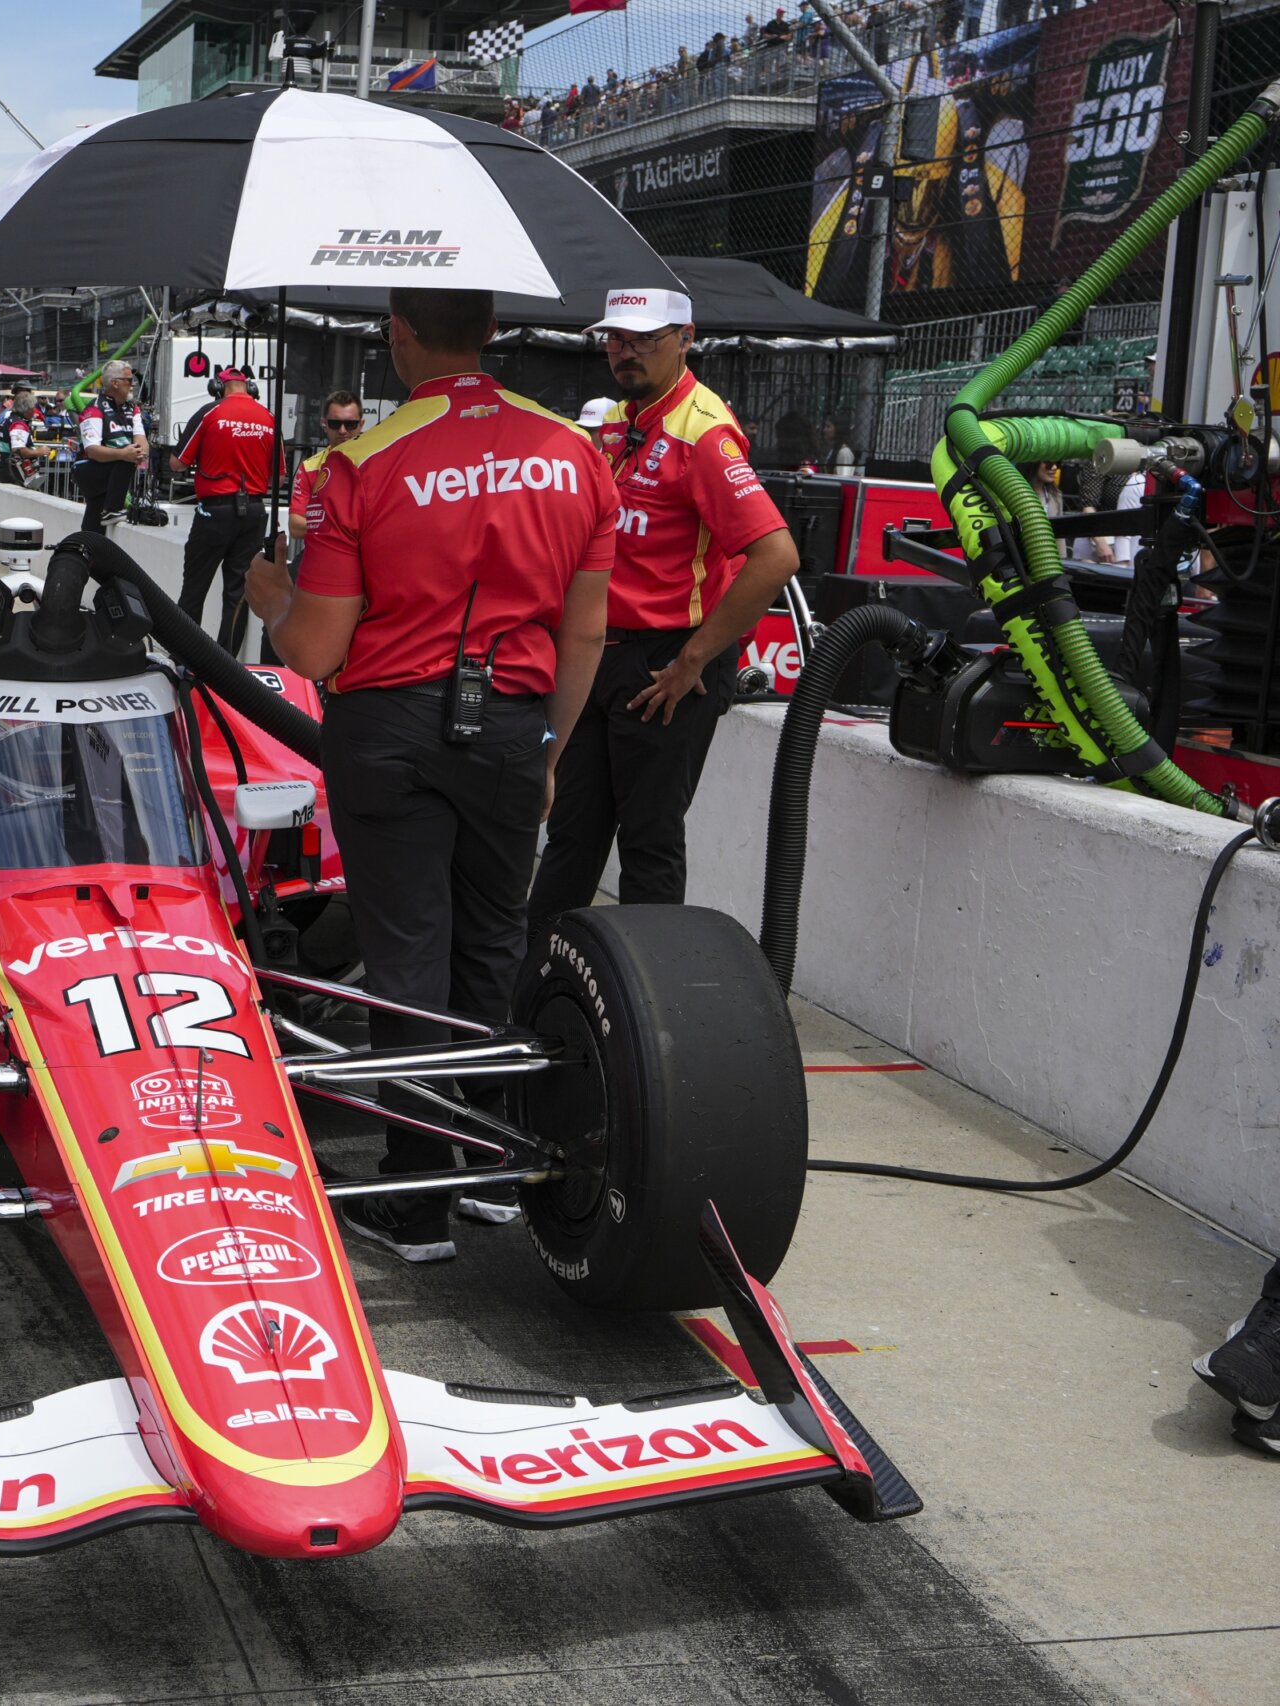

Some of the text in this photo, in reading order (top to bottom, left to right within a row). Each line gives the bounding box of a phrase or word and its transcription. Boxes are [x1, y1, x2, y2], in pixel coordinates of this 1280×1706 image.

[1097, 52, 1153, 93] INDY
[1065, 85, 1165, 163] 500
[871, 175, 884, 189] 9
[338, 229, 443, 246] TEAM
[310, 250, 460, 267] PENSKE
[608, 293, 647, 307] verizon
[217, 418, 274, 435] Firestone
[231, 428, 265, 440] Racing
[404, 451, 578, 507] verizon
[55, 692, 158, 713] POWER
[122, 731, 154, 740] verizon
[244, 783, 308, 793] SIEMENS
[8, 926, 252, 977] verizon
[549, 933, 611, 1038] Firestone
[63, 971, 254, 1062] 12
[175, 1079, 222, 1090] NTT
[138, 1094, 235, 1111] INDYCAR
[133, 1187, 306, 1221] TIRE RACK
[248, 1204, 292, 1215] .com
[181, 1243, 297, 1276] PENNZOIL
[227, 1403, 360, 1429] dallara
[444, 1419, 769, 1485] verizon
